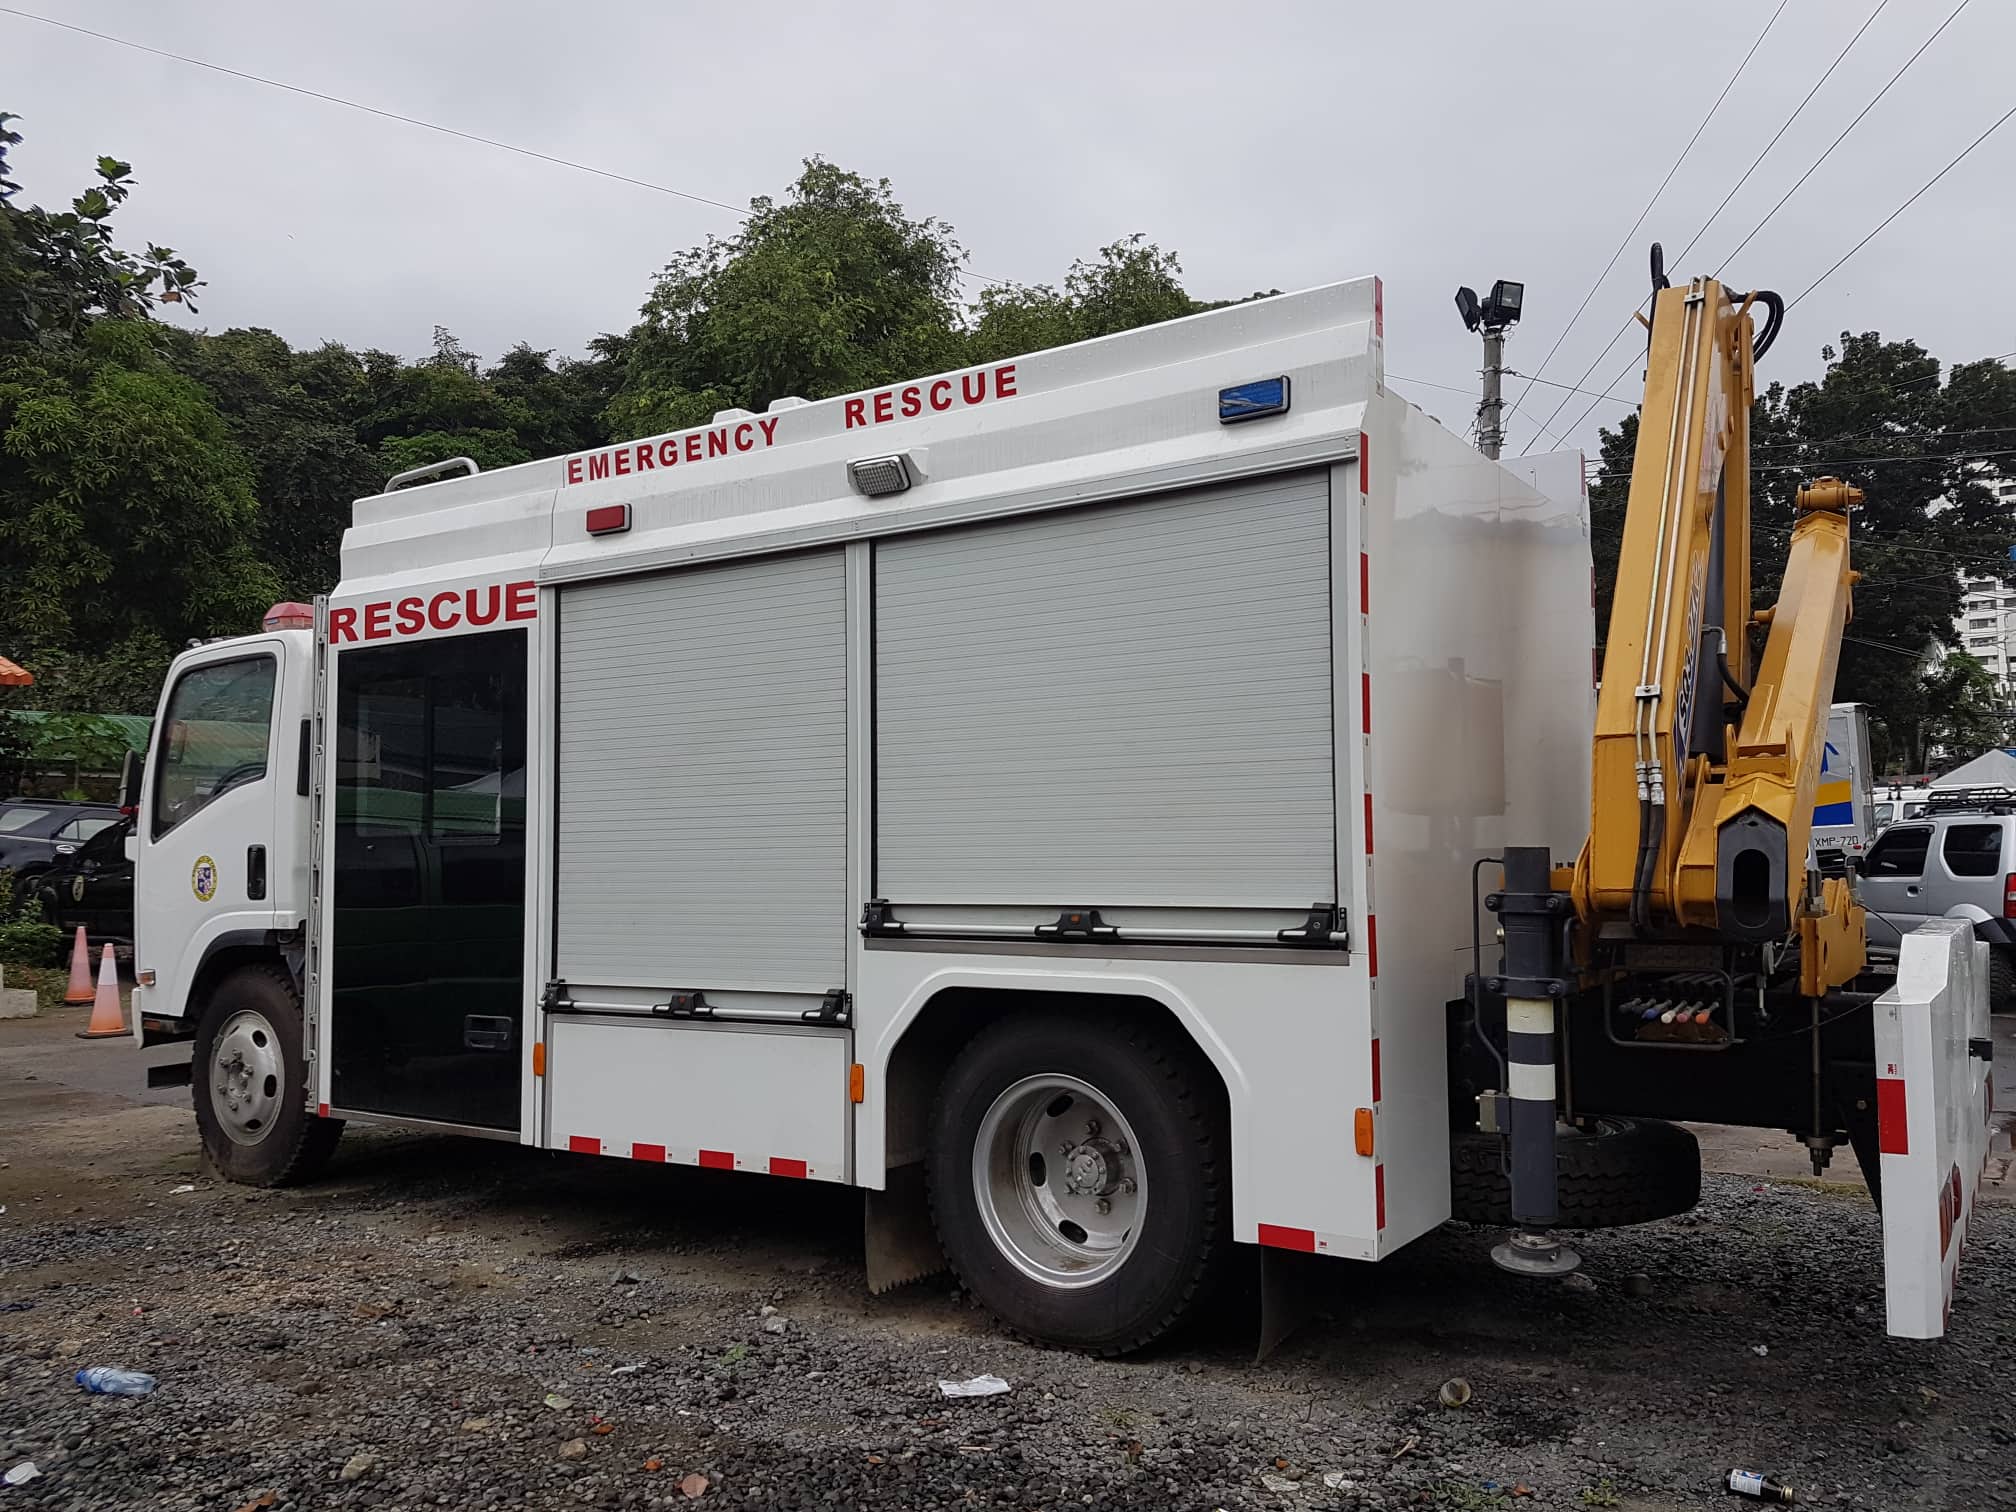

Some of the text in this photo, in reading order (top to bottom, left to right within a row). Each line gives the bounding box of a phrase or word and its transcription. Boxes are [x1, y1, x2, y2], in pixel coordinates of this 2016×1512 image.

[567, 364, 1018, 485] EMERGENCY RESCUE
[328, 580, 539, 645] RESCUE
